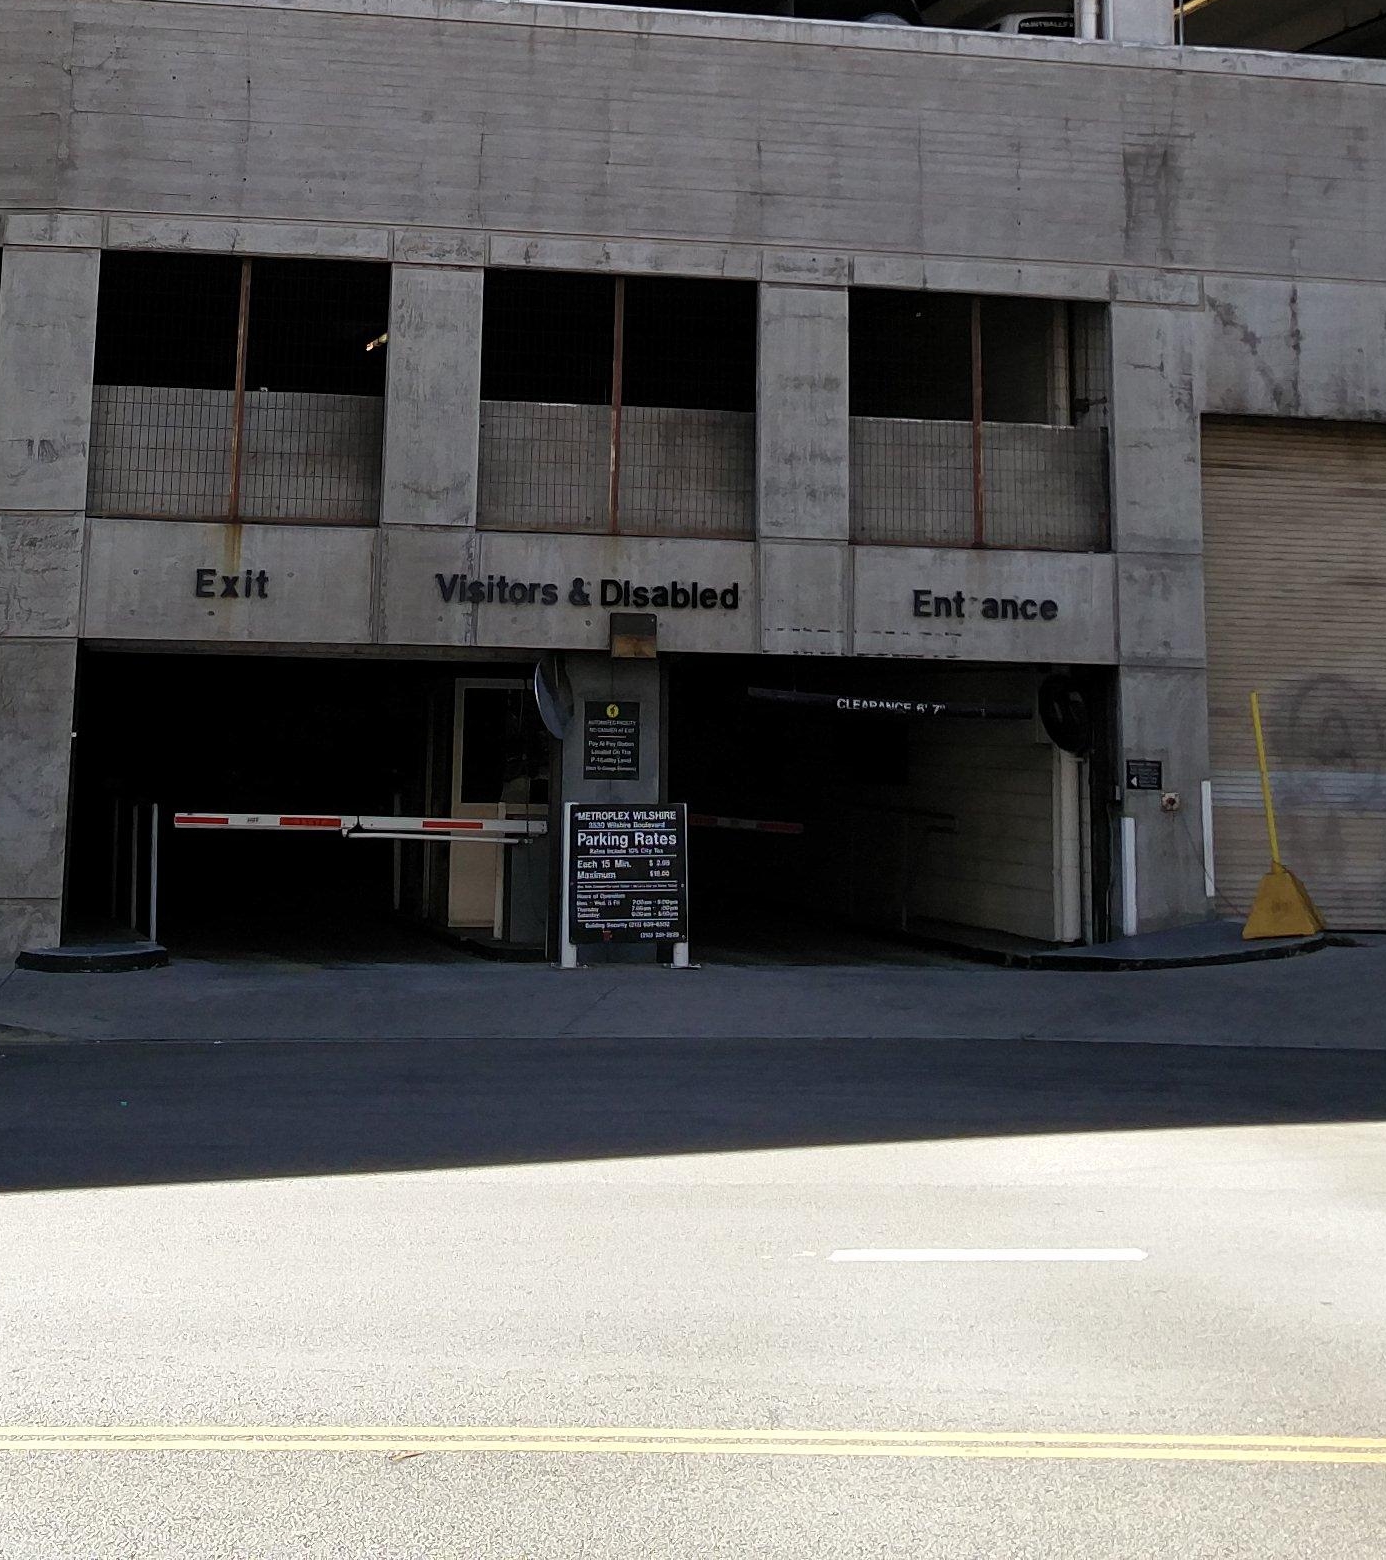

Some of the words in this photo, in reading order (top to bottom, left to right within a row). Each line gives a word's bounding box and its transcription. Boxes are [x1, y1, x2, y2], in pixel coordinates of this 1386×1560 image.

[196, 569, 269, 598] Exit
[435, 574, 559, 606] Visitors
[569, 578, 591, 606] &
[912, 589, 1058, 621] Entance
[578, 811, 630, 821] METROPLEX
[633, 811, 676, 820] WILSHIRE
[577, 832, 628, 848] Parking
[634, 832, 677, 846] Rates
[577, 860, 598, 869] Each
[601, 860, 611, 868] 15
[614, 860, 632, 868] Min.
[577, 870, 616, 880] Maximum
